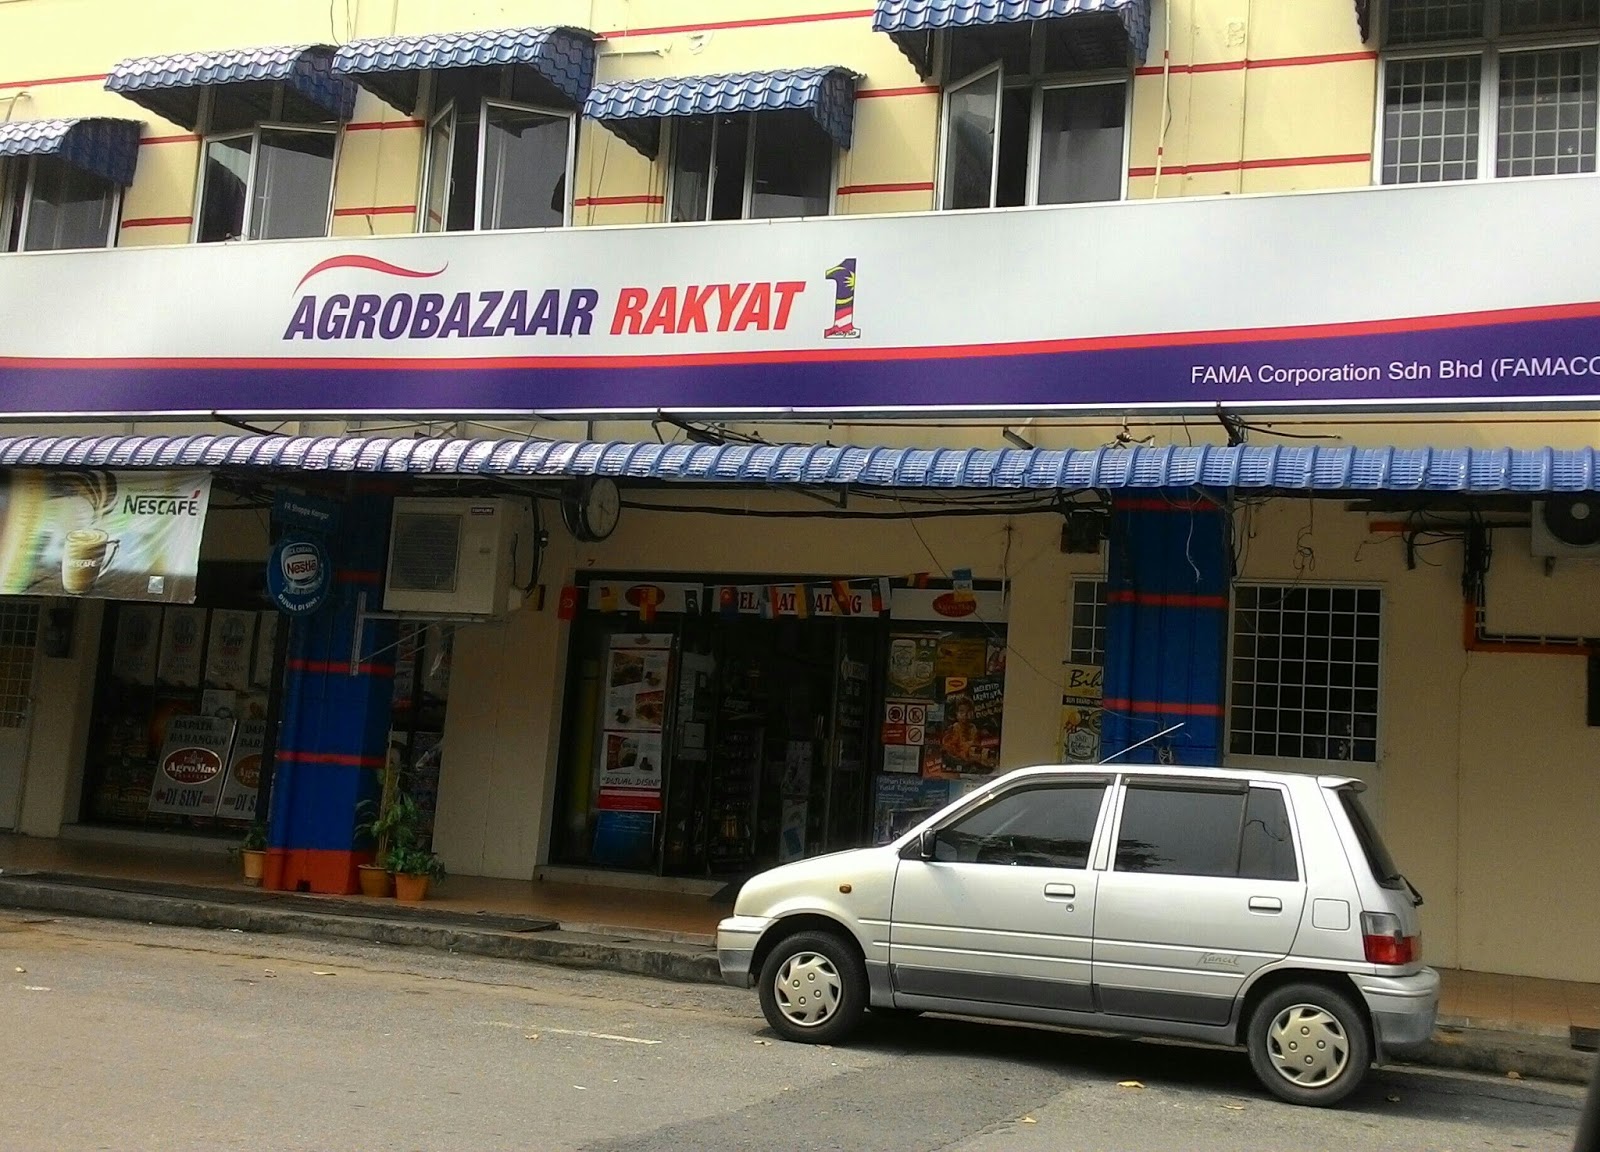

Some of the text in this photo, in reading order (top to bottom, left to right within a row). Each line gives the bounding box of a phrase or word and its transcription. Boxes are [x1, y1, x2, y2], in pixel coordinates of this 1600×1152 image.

[283, 288, 599, 340] AGROBAZAAR
[609, 281, 806, 335] RAKYAT
[1191, 365, 1253, 384] FAMA
[1258, 363, 1381, 387] Corporation
[1388, 361, 1431, 380] Sdn
[1439, 359, 1483, 379] Bhd
[278, 594, 298, 612] DIJUAL
[166, 761, 217, 774] AgroMas
